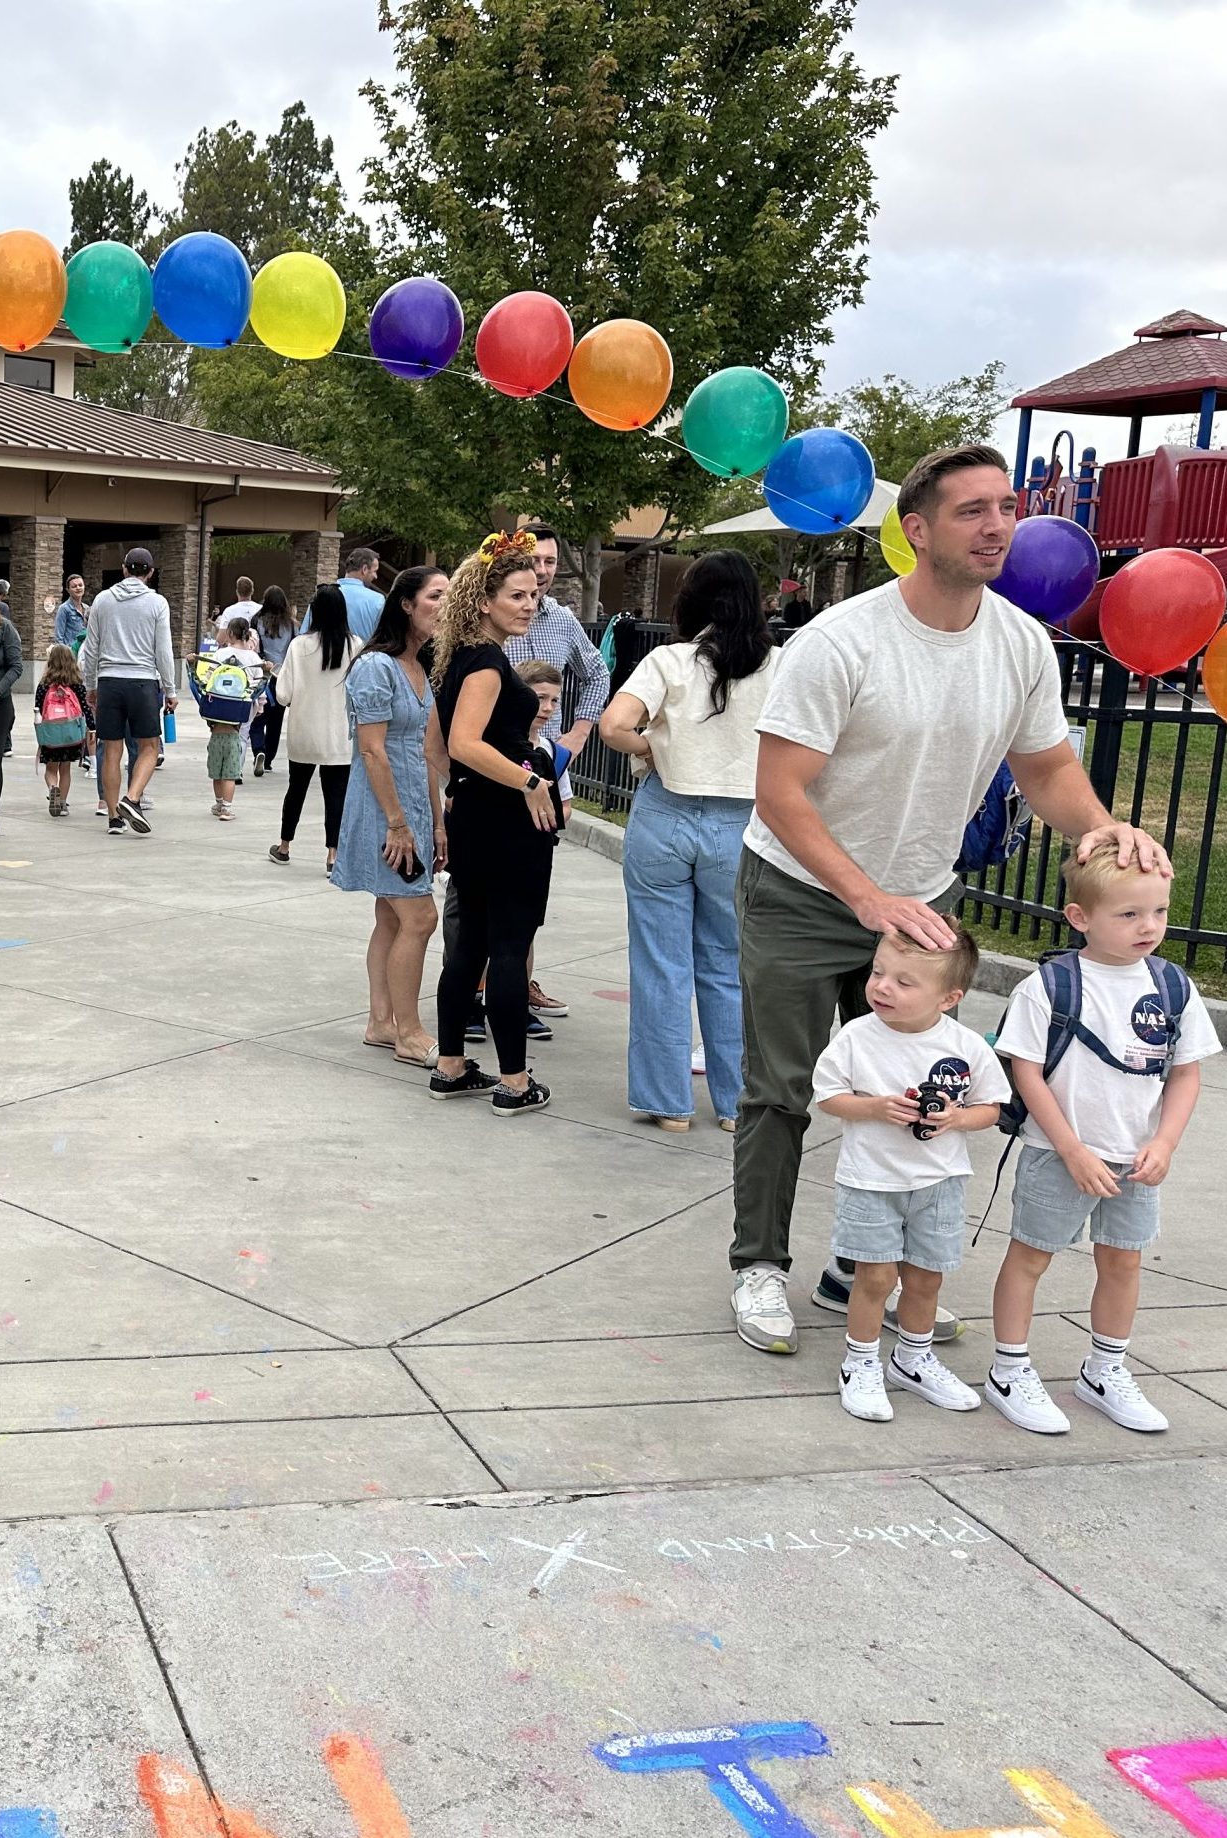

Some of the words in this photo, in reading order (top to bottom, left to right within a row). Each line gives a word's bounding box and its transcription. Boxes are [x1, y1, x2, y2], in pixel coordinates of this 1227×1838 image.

[1134, 1011, 1167, 1026] NAS
[932, 1073, 971, 1086] NASA
[658, 1529, 851, 1564] STAND
[272, 1546, 493, 1580] HERE
